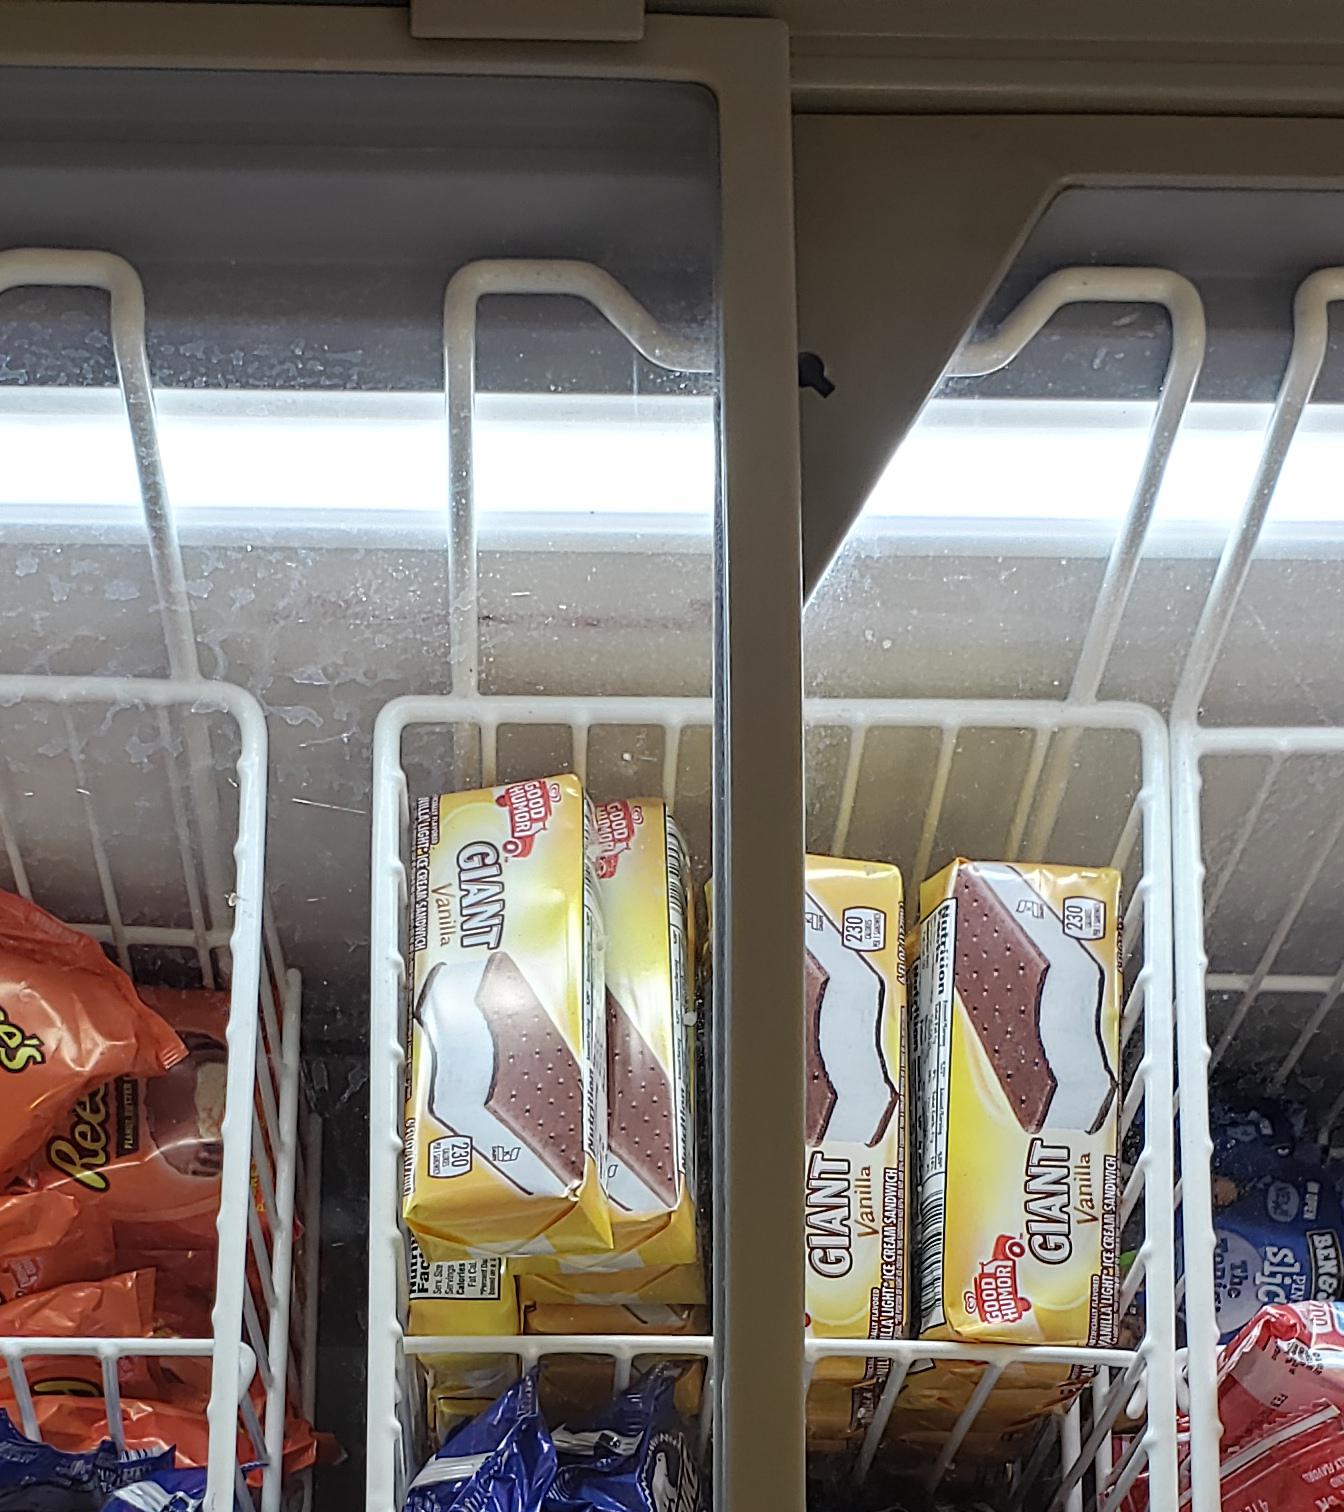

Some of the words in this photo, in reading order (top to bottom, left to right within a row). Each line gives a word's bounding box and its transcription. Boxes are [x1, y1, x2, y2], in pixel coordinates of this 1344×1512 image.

[508, 785, 531, 833] HUMOR
[524, 782, 545, 820] GOOD
[607, 803, 628, 839] GOOD
[431, 882, 457, 947] Vanilla
[458, 841, 505, 950] GIANT
[1064, 905, 1083, 931] 230
[414, 903, 428, 950] SANDWICH
[845, 917, 863, 943] 230
[938, 905, 949, 995] Nutrition
[452, 1142, 470, 1168] 230
[857, 1166, 878, 1239] Vanilla
[885, 1167, 898, 1225] SANDWICH
[1025, 1138, 1072, 1264] GIANT
[1074, 1152, 1099, 1225] Vanilla
[1104, 1155, 1117, 1212] SANDWICH
[807, 1152, 853, 1278] GIANT
[1103, 1214, 1116, 1249] CREAM
[882, 1227, 896, 1259] CREAM
[1103, 1251, 1115, 1268] ICE
[882, 1262, 895, 1281] ICE
[999, 1264, 1018, 1322] HUMOR
[984, 1276, 1003, 1323] GOOD
